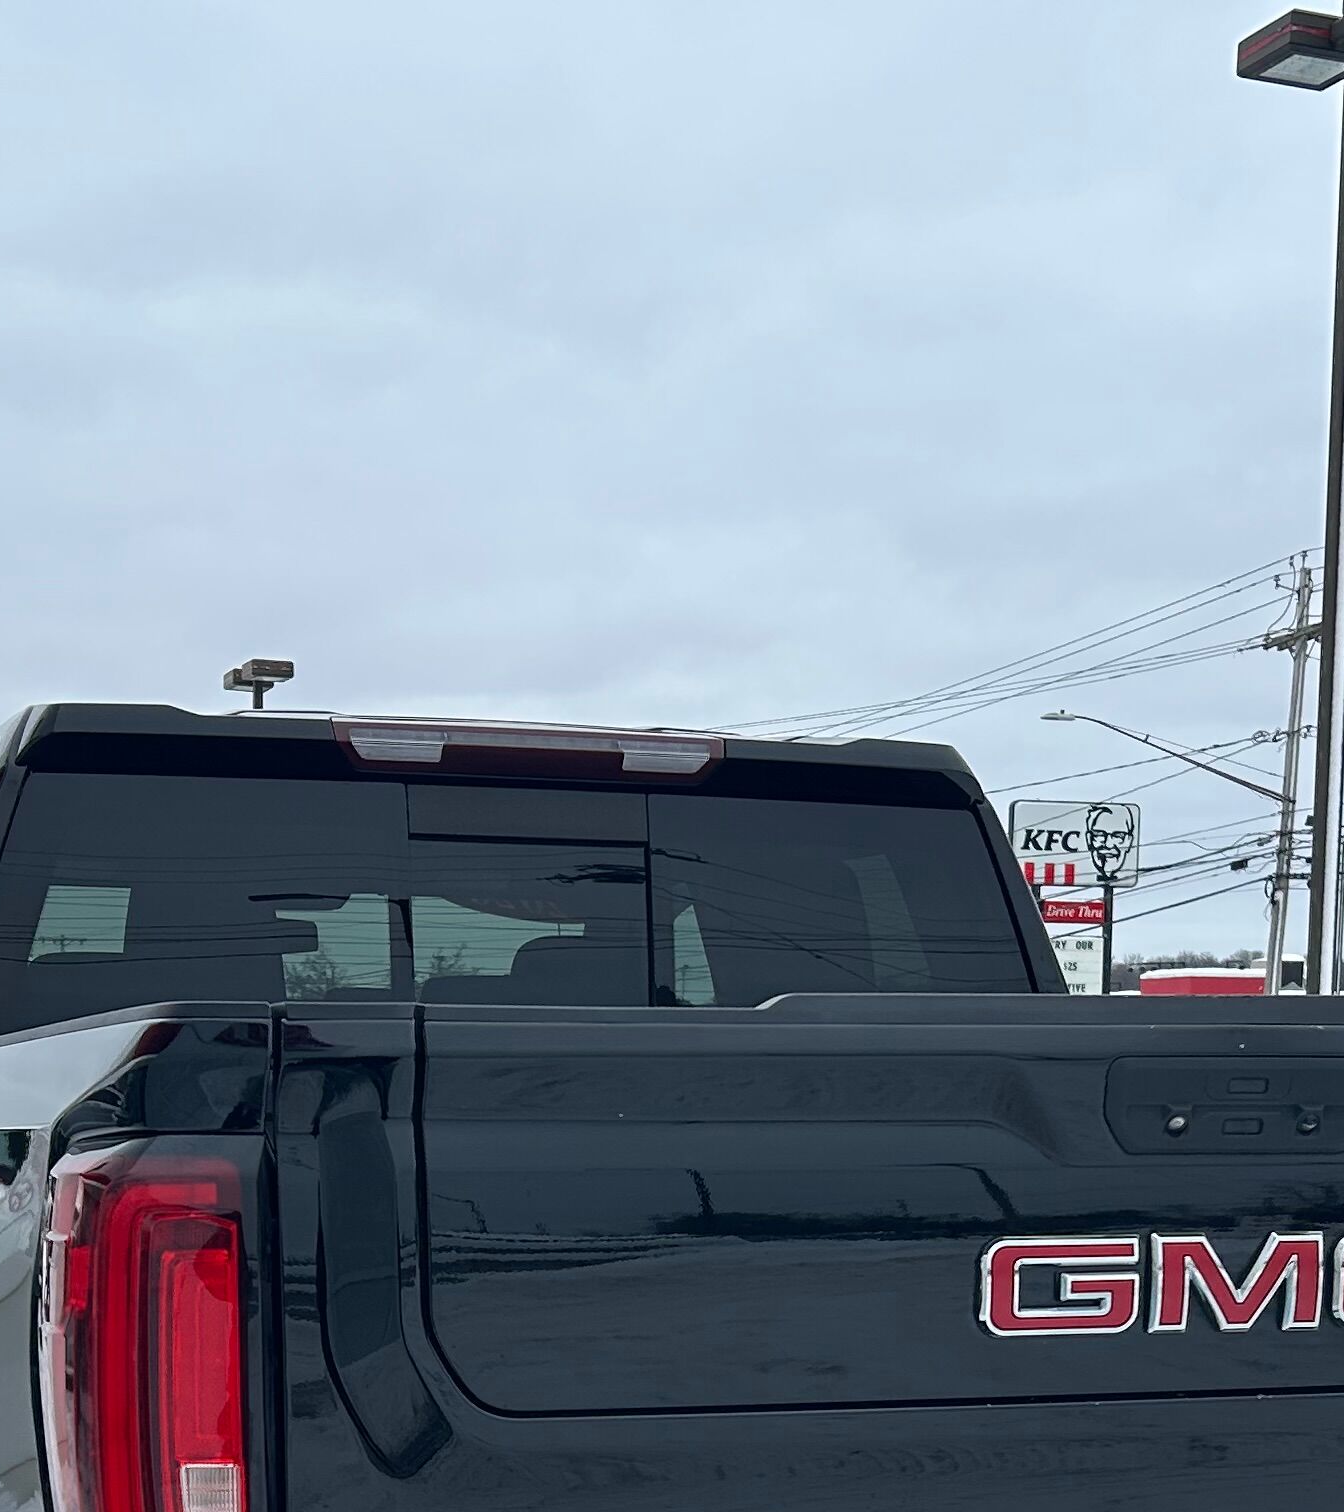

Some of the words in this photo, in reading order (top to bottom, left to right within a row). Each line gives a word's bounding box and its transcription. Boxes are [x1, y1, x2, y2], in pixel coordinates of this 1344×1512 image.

[1020, 828, 1081, 853] KFC
[1046, 904, 1075, 918] Drive
[1077, 905, 1103, 918] Thru
[1076, 940, 1093, 950] OUR
